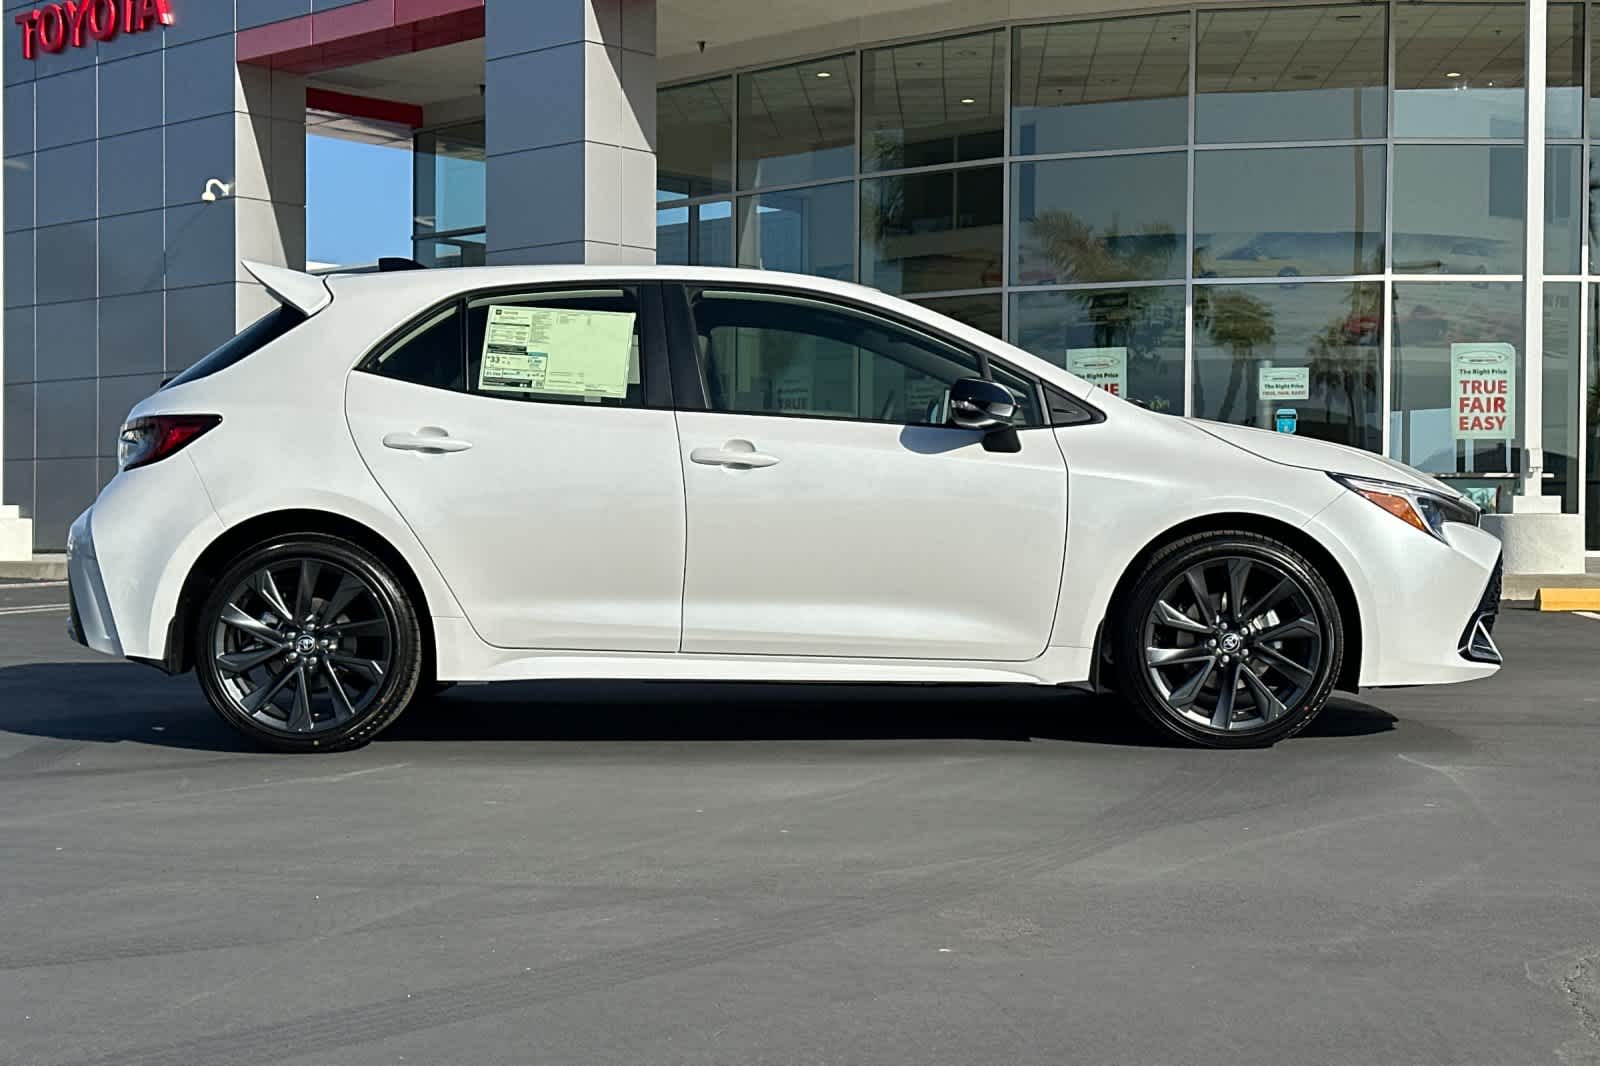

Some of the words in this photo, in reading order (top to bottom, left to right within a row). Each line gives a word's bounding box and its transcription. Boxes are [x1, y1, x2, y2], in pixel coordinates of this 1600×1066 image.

[15, 0, 174, 60] TOYOTA
[1460, 380, 1507, 394] TRUE
[1459, 397, 1506, 413] FAIR
[1459, 416, 1506, 431] EASY
